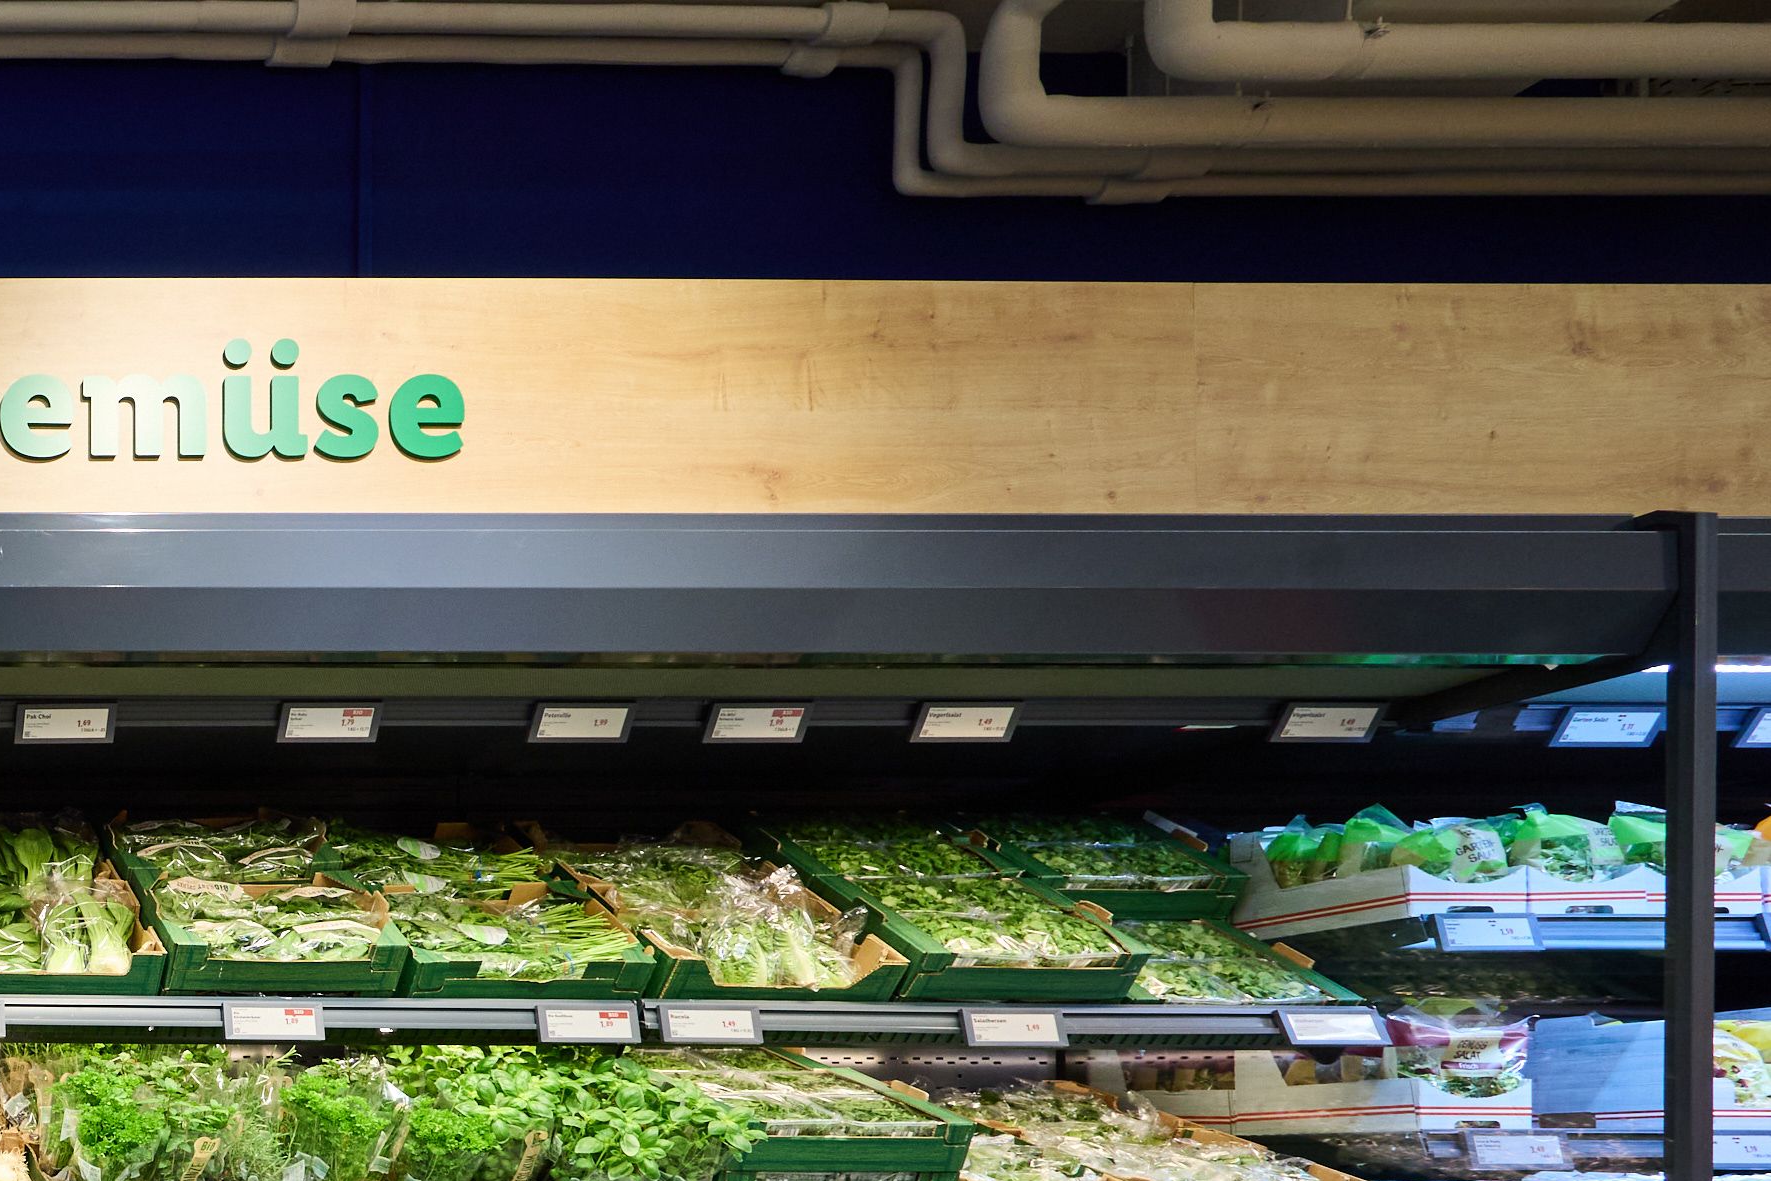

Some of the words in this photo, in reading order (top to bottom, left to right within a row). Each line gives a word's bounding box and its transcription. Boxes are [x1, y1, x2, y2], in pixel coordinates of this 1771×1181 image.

[77, 720, 91, 728] 1.69
[342, 719, 355, 727] 1.79
[594, 719, 608, 727] 1.99
